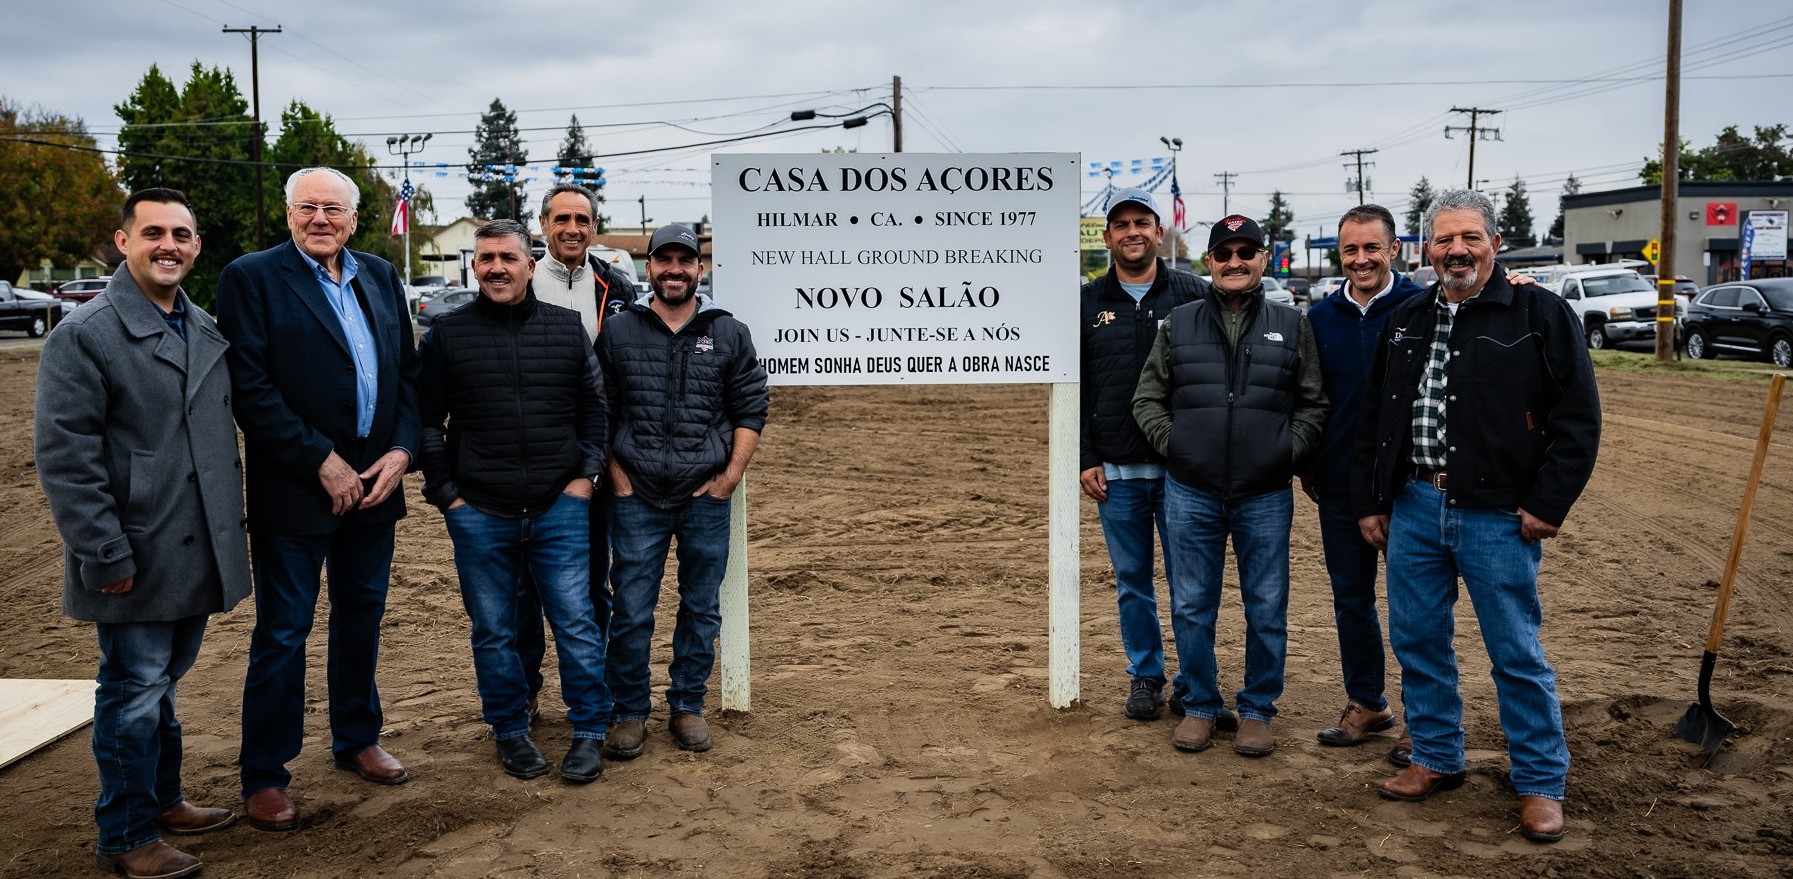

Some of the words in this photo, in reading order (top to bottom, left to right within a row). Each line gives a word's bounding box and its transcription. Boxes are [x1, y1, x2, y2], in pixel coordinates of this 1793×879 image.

[739, 167, 831, 193] CASA
[839, 167, 908, 192] DOS
[916, 166, 1054, 195] AÇORES
[756, 212, 839, 227] HILMAR
[871, 211, 903, 227] CA.
[936, 211, 993, 226] SINCE
[1000, 211, 1037, 226] 1977
[751, 251, 796, 265] NEW
[801, 250, 852, 265] HALL
[857, 249, 939, 265] GROUND
[944, 248, 1042, 264] BREAKING
[795, 287, 883, 310] NOVO
[899, 281, 1000, 309] SALÃO
[774, 328, 820, 344] JOIN
[826, 328, 850, 343] US
[866, 327, 959, 343] JUNTE-SE
[963, 328, 976, 342] A
[983, 323, 1021, 342] NÓS
[815, 357, 862, 374] SONHA
[867, 356, 902, 374] DEUS
[907, 356, 943, 374] QUER
[947, 356, 958, 373] A
[963, 355, 1000, 373] OBRA
[1005, 355, 1050, 372] NASCE
